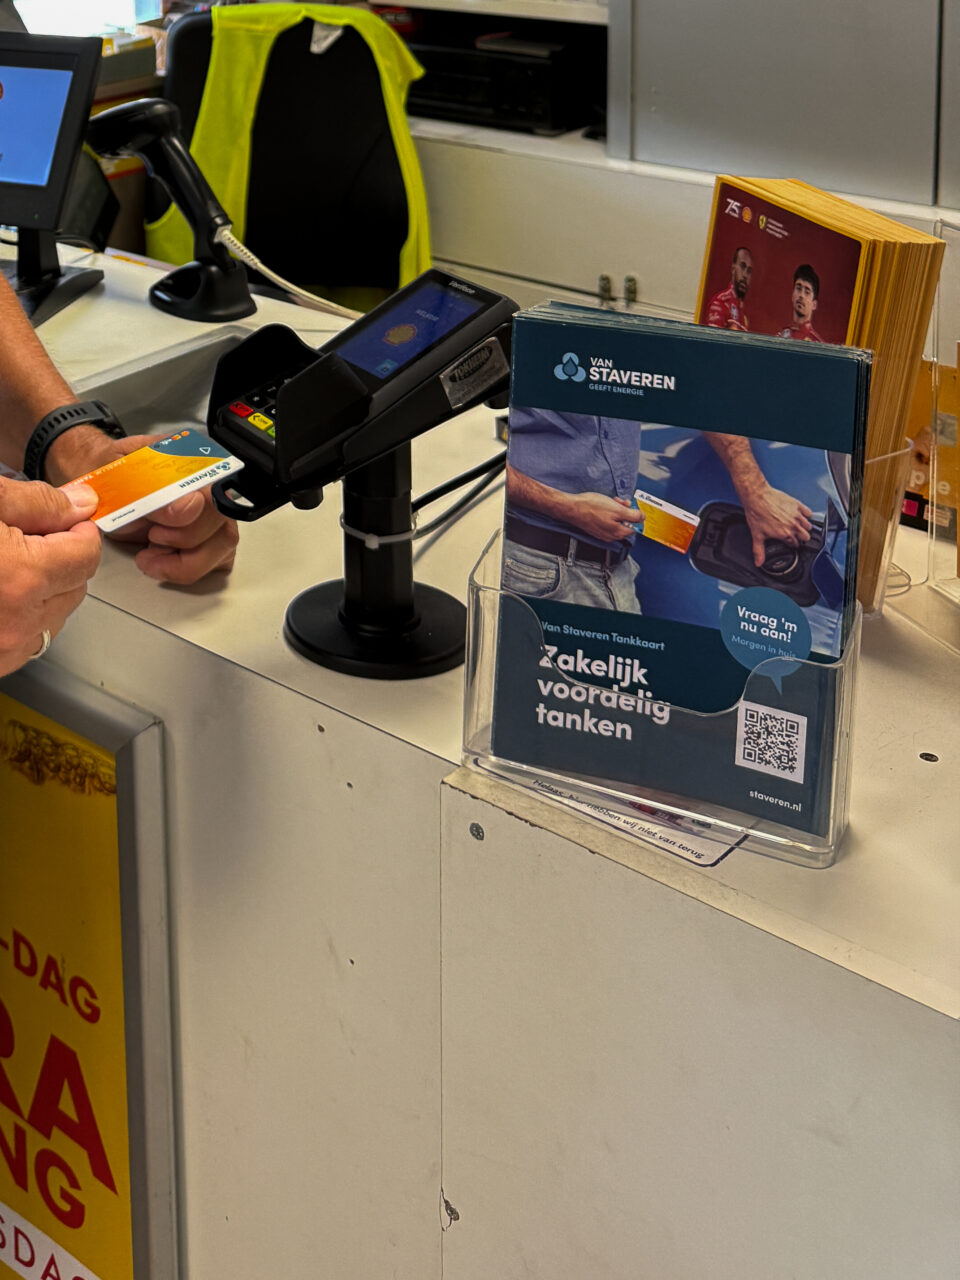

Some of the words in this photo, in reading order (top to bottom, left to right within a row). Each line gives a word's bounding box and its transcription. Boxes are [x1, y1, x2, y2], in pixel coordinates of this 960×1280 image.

[590, 356, 613, 369] VAN
[589, 367, 676, 391] STAVEREN
[589, 383, 611, 392] GEEFT
[613, 386, 645, 396] ENERGIE
[737, 605, 777, 629] Vraag
[541, 621, 561, 633] Van
[562, 624, 610, 641] Staveren
[611, 632, 666, 651] Tankkaart
[740, 621, 757, 633] nu
[760, 627, 792, 643] aan!
[731, 635, 766, 650] Morgen
[768, 644, 777, 654] in
[539, 644, 649, 688] Zakelijk
[536, 678, 672, 726] voordelig
[536, 702, 633, 741] tanken
[749, 790, 802, 812] staveren.nl
[622, 818, 638, 829] wij
[638, 825, 657, 838] niet
[658, 835, 677, 846] van
[678, 843, 706, 859] terug
